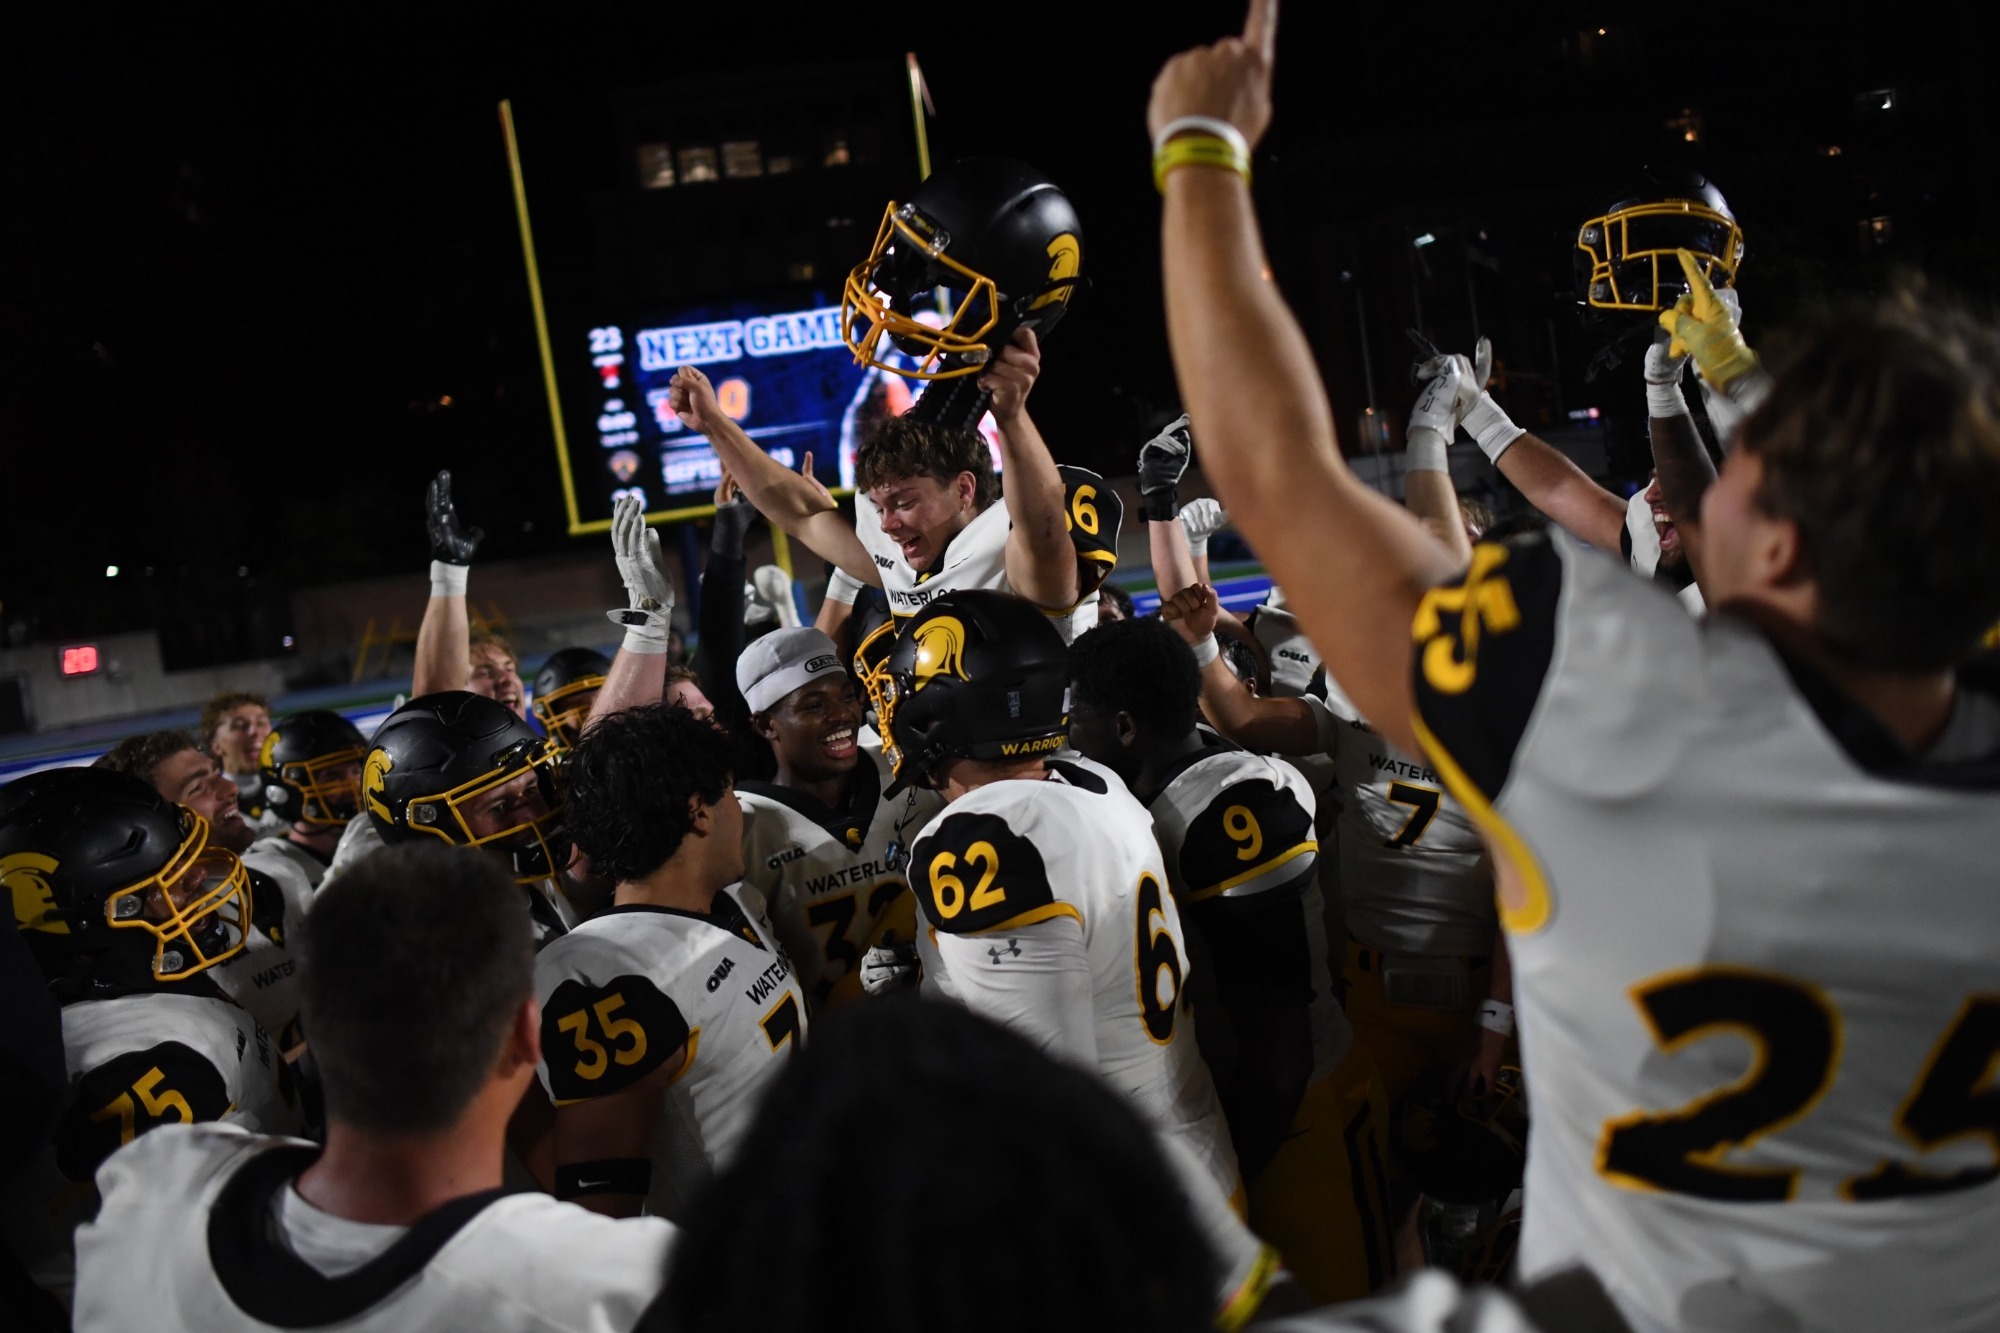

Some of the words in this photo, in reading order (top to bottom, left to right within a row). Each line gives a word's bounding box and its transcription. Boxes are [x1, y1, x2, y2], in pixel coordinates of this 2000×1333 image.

[588, 325, 624, 353] 23
[636, 320, 744, 372] NEXT
[744, 305, 858, 358] GAME
[1062, 483, 1099, 536] 6
[887, 588, 956, 606] WATERLO
[1278, 649, 1310, 664] OUA
[1368, 753, 1440, 784] WATER
[1223, 804, 1263, 861] 9
[1384, 780, 1443, 850] 7
[806, 851, 911, 896] WATERLO
[929, 840, 1006, 919] 62
[706, 956, 736, 994] OUA
[745, 951, 790, 1006] WATER
[1134, 870, 1192, 1047] 6
[557, 991, 647, 1080] 35
[90, 1065, 193, 1146] 75
